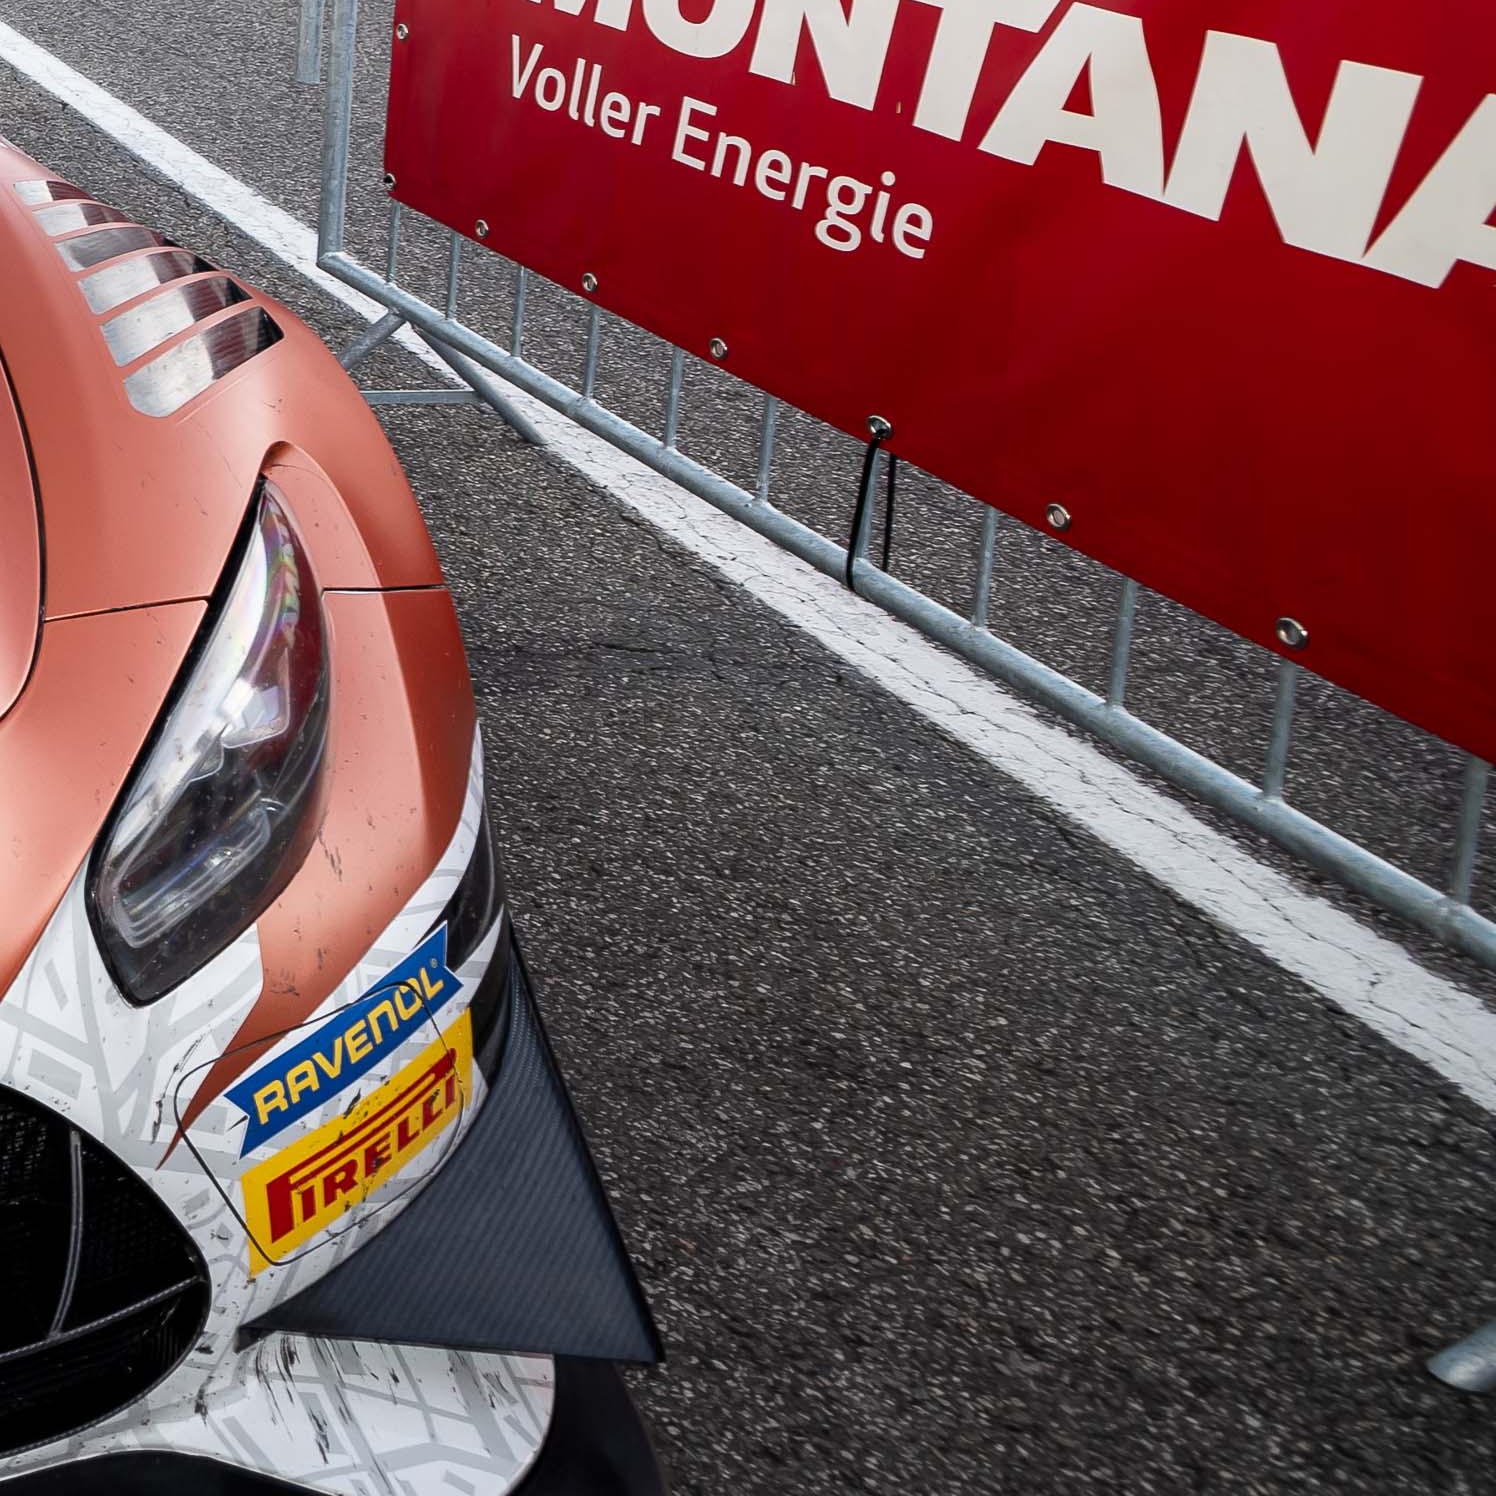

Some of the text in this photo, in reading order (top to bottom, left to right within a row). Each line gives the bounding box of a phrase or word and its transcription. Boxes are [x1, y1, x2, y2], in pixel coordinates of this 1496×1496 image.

[509, 33, 936, 261] Voller Energie
[266, 1047, 458, 1244] PIRELLI
